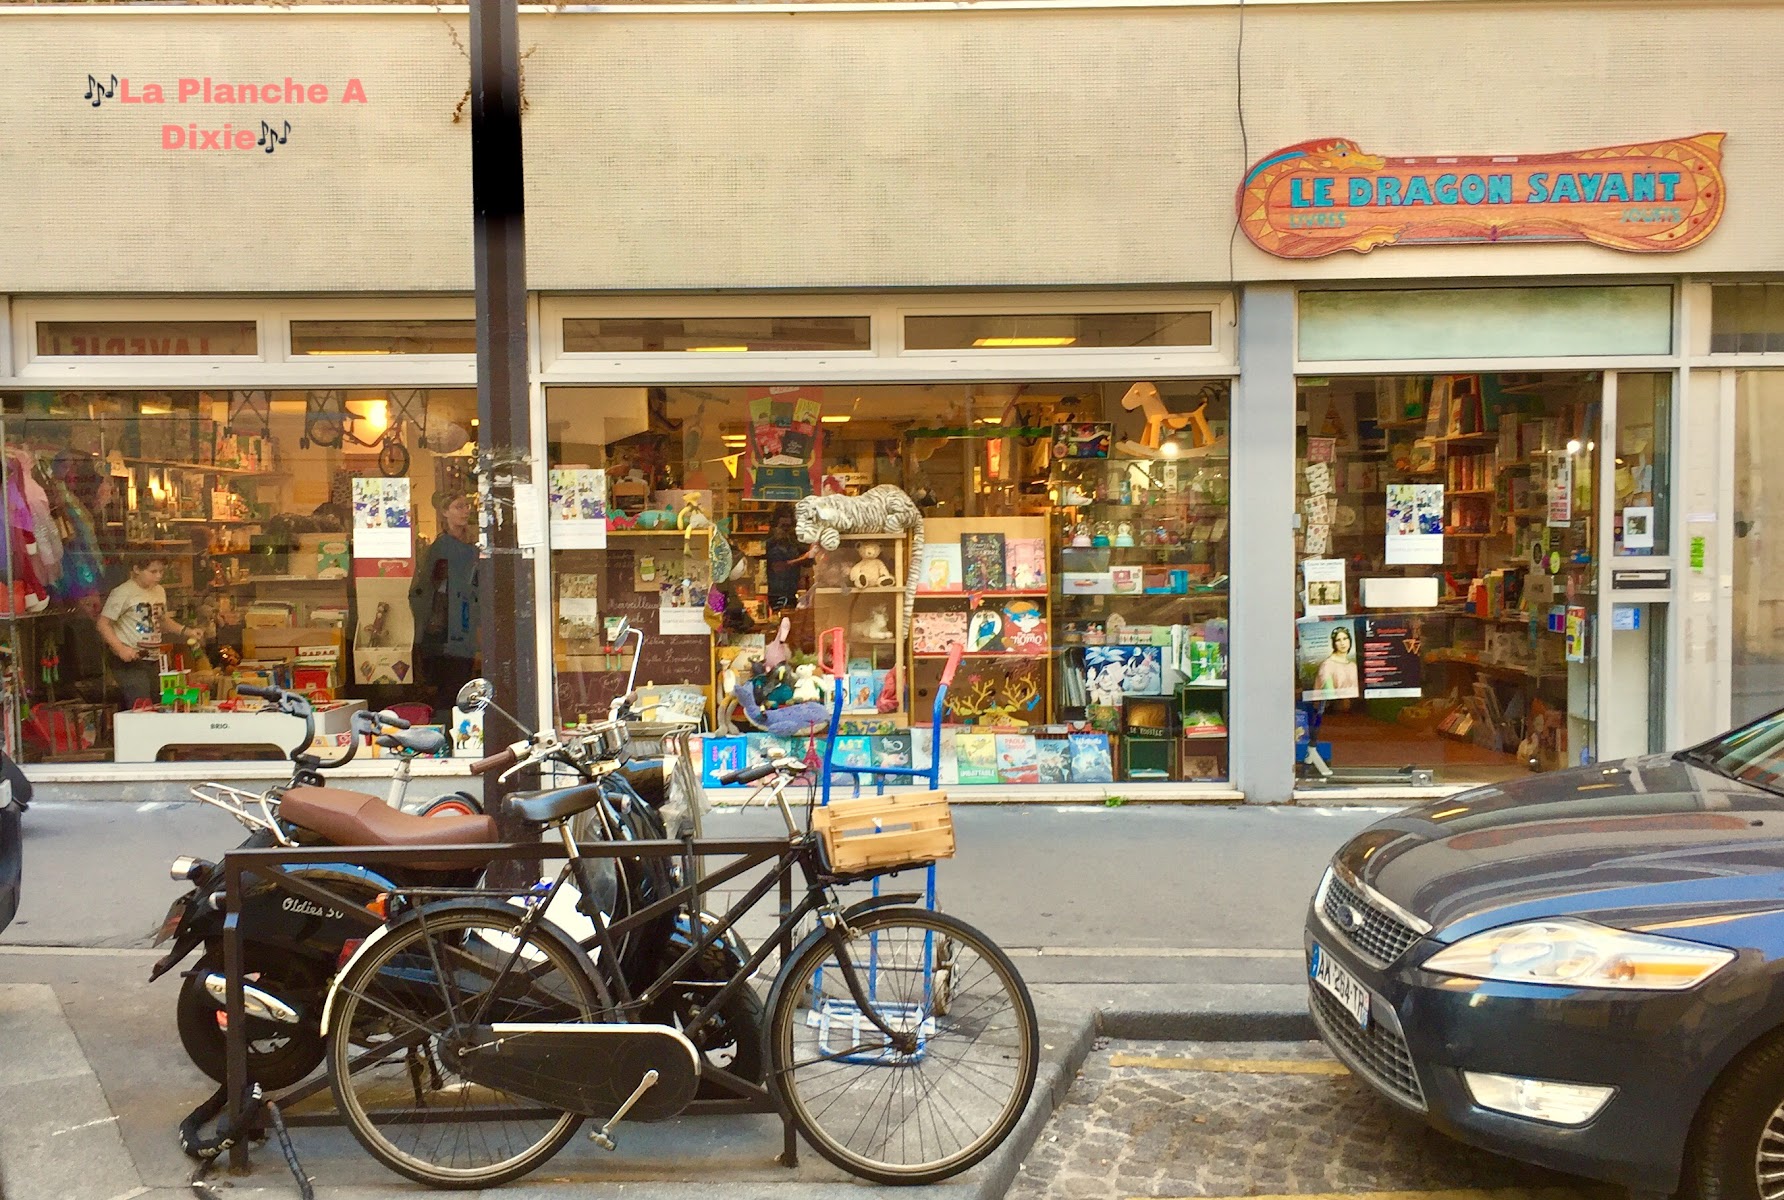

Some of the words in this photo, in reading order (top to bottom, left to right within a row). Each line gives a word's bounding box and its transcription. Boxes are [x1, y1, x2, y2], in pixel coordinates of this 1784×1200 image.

[1290, 177, 1335, 208] LE
[1348, 173, 1513, 207] DRAGON
[1527, 171, 1681, 203] SAVANT
[1289, 211, 1347, 229] LIVRES
[282, 897, 323, 916] Oldies
